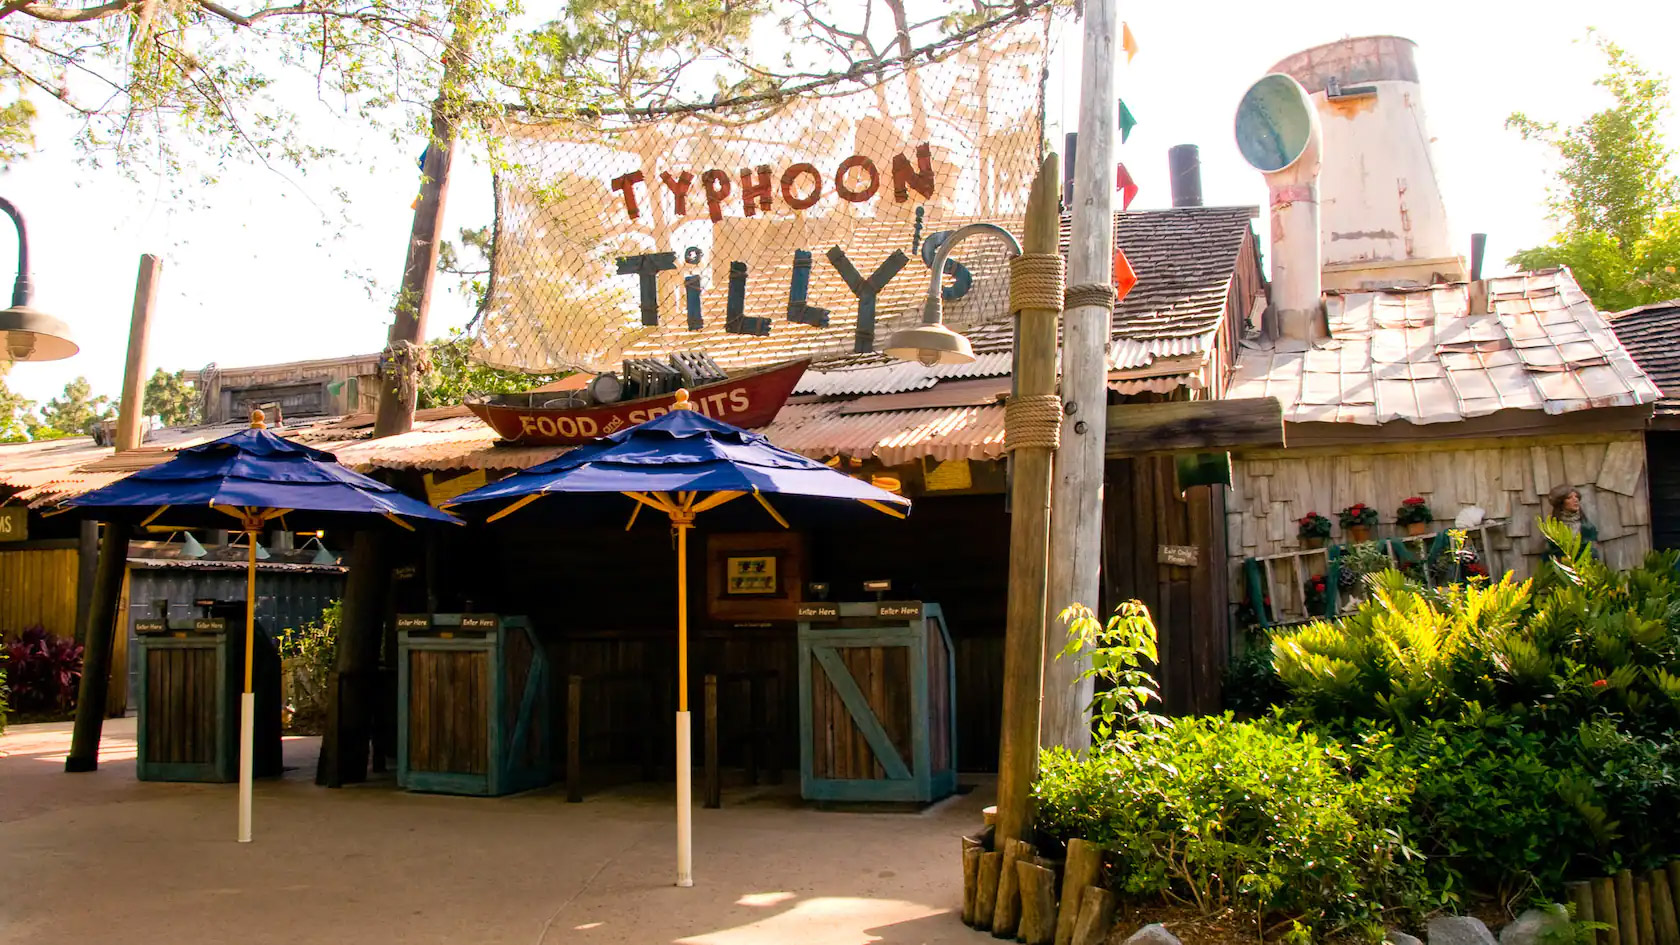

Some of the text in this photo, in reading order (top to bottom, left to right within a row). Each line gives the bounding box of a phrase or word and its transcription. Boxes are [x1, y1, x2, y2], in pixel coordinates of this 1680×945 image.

[611, 142, 935, 223] TYPHOON
[519, 387, 750, 438] FOOD and SPITS
[798, 607, 836, 616] Enter Here
[880, 606, 919, 616] Enter Here
[463, 618, 478, 626] Enter
